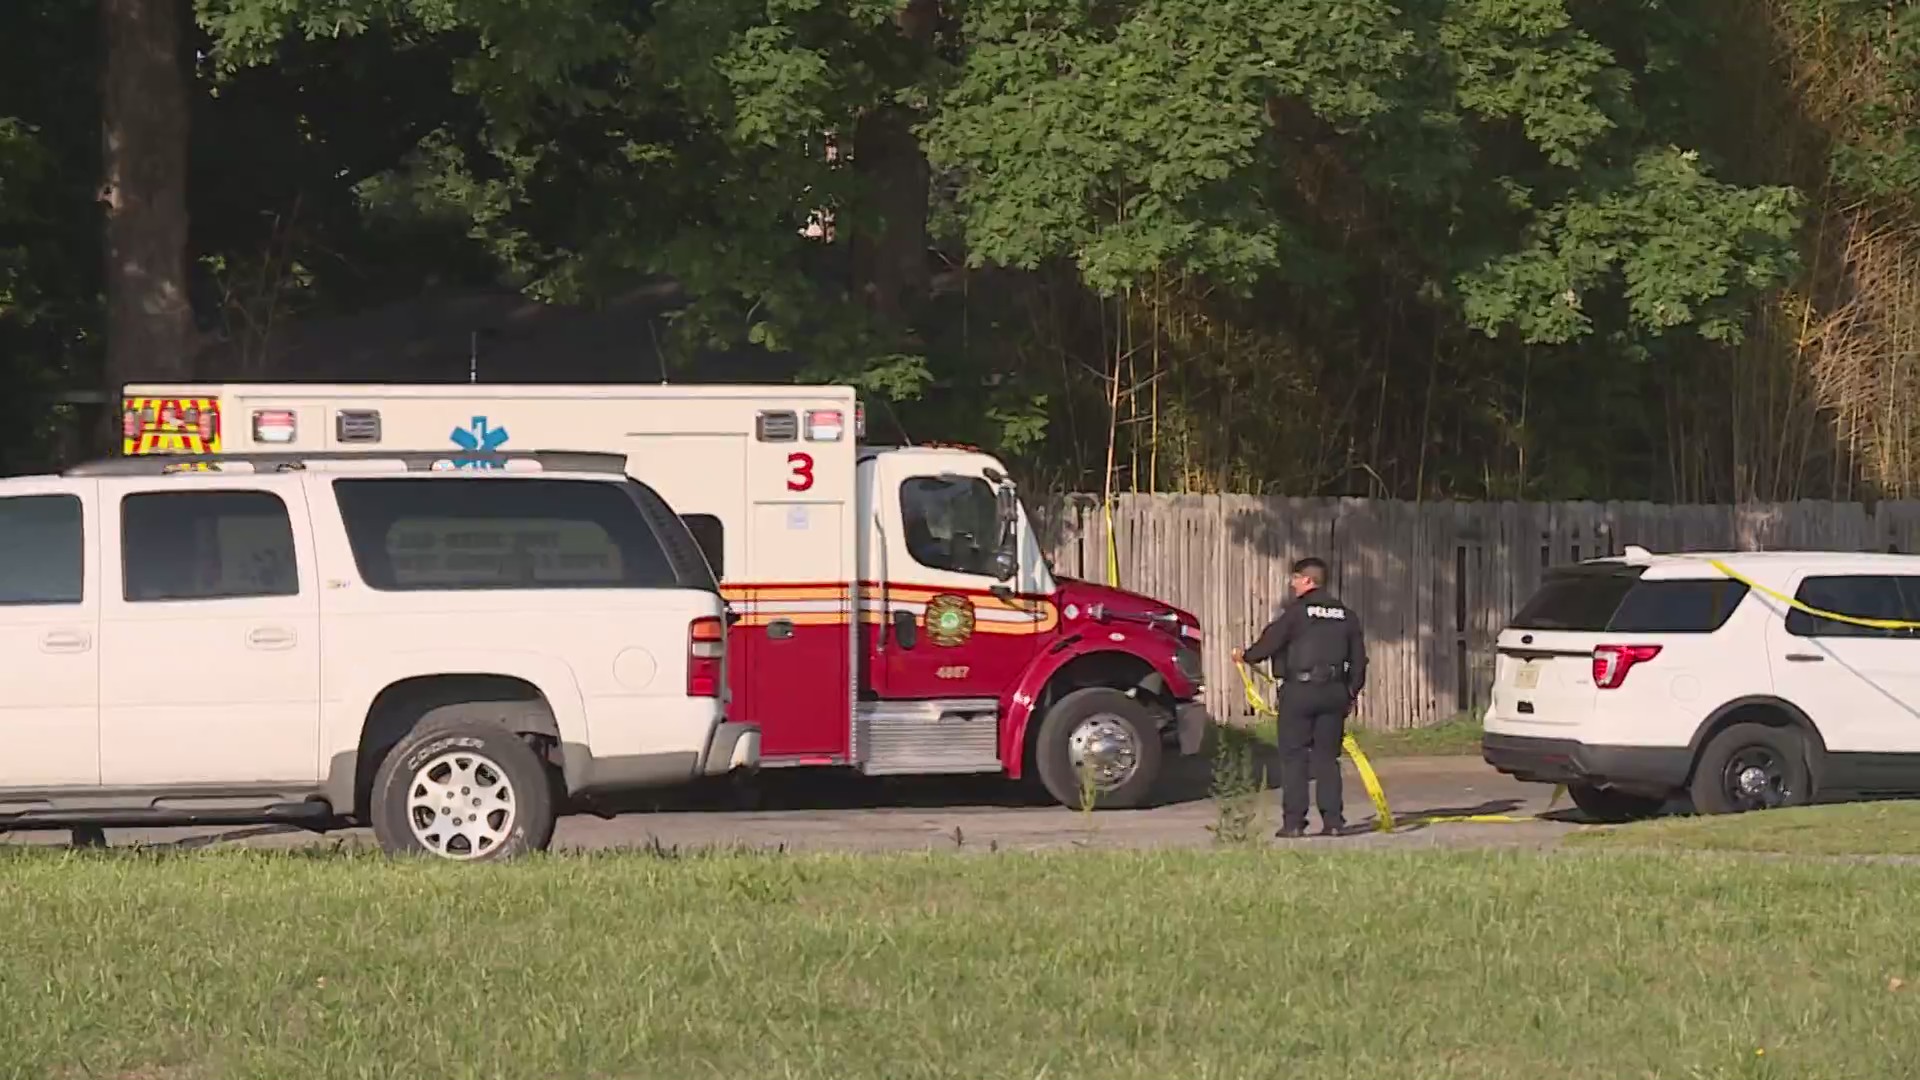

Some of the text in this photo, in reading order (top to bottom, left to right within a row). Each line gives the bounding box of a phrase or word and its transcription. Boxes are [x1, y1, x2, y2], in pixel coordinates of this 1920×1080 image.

[787, 452, 814, 492] 3
[1307, 605, 1345, 619] POLICE
[408, 737, 484, 771] COOPER
